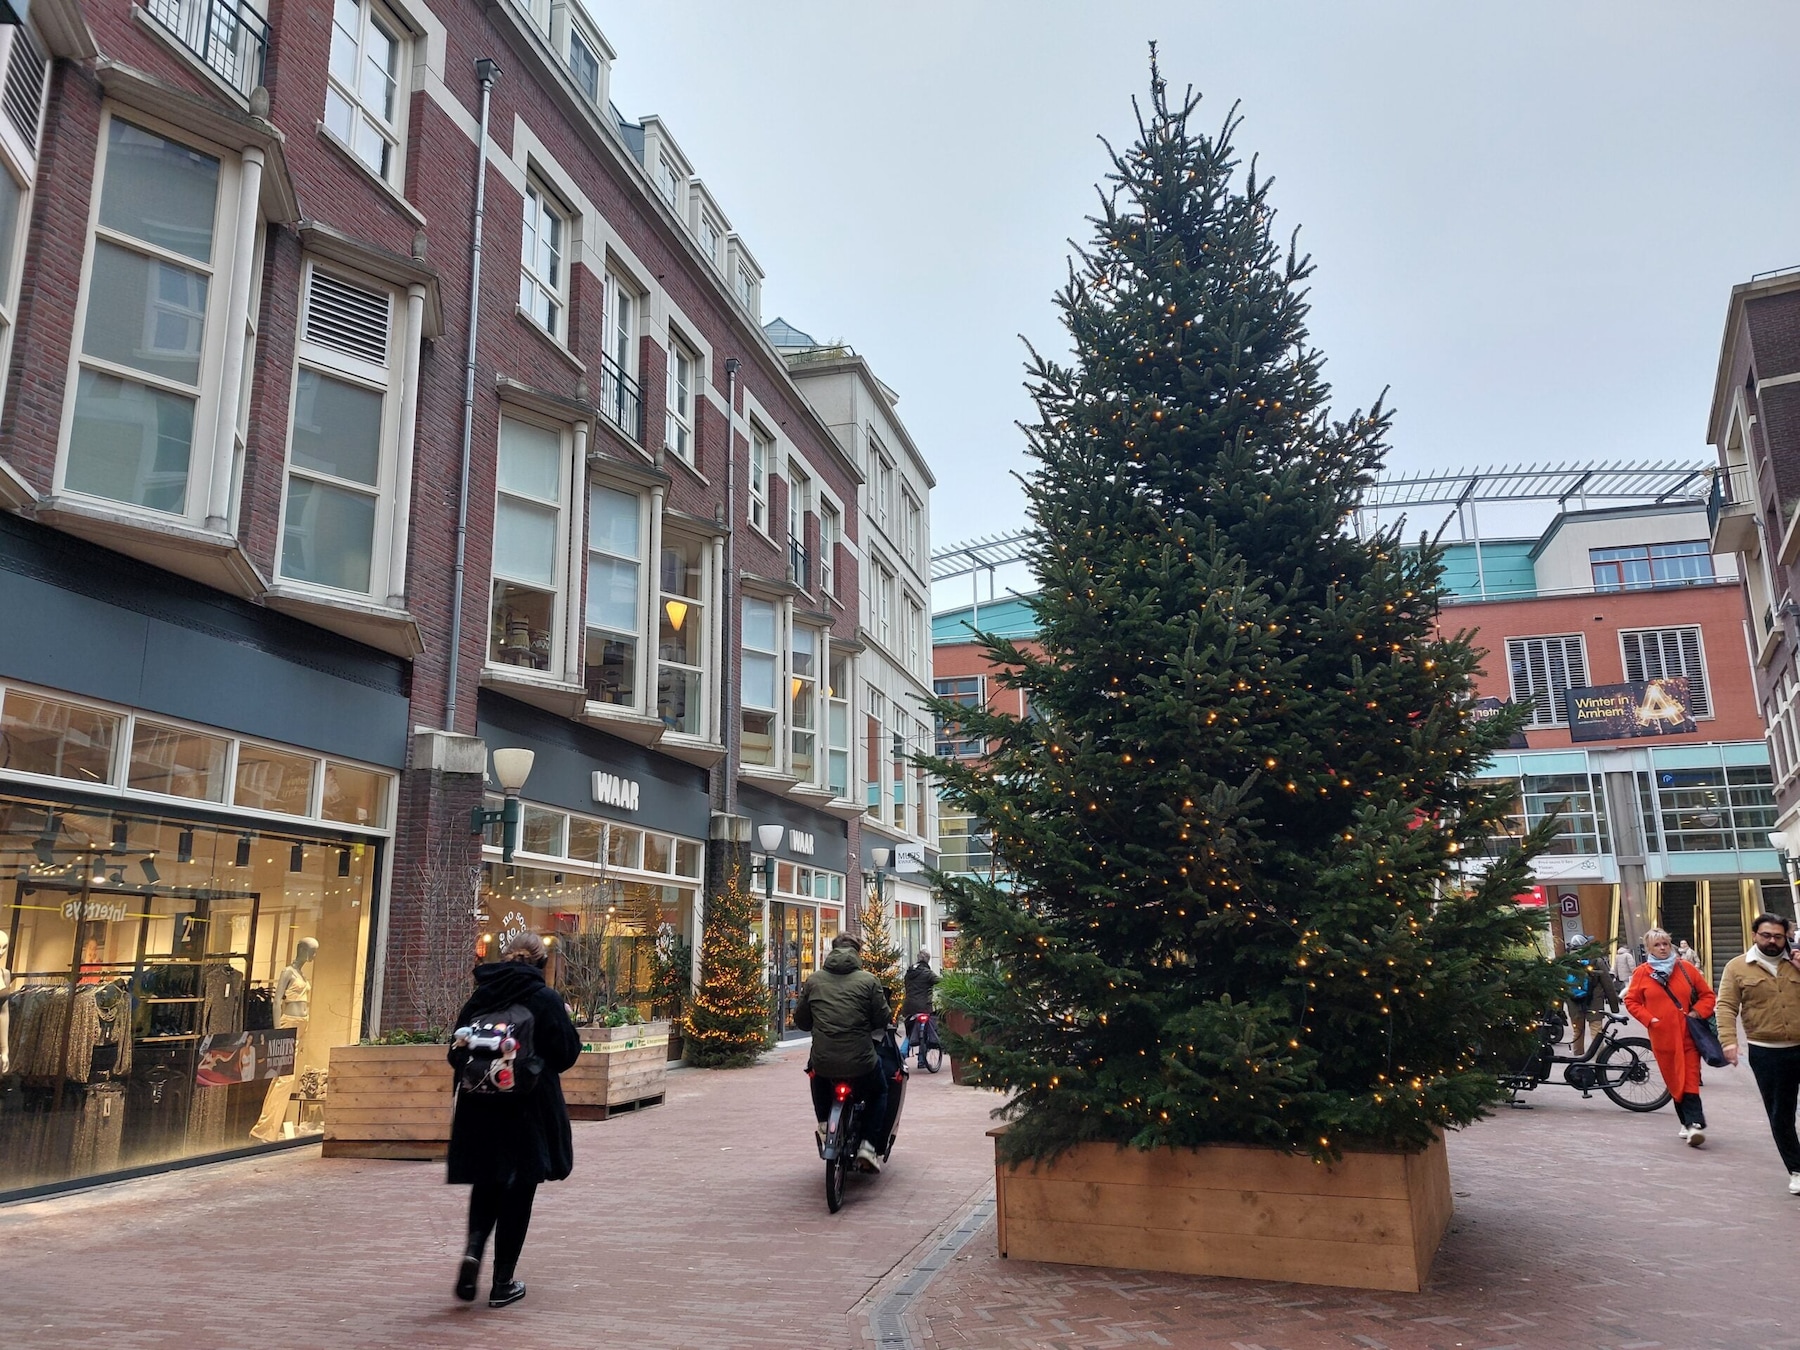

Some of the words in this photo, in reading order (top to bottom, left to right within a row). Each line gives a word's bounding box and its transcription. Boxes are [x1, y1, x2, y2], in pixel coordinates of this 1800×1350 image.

[1575, 696, 1614, 708] Winter
[1618, 695, 1629, 704] in
[1577, 707, 1624, 719] Arnhem
[592, 770, 640, 811] WAAR
[789, 829, 815, 856] WAAR
[502, 911, 514, 927] no
[267, 1038, 295, 1057] NIGHTS
